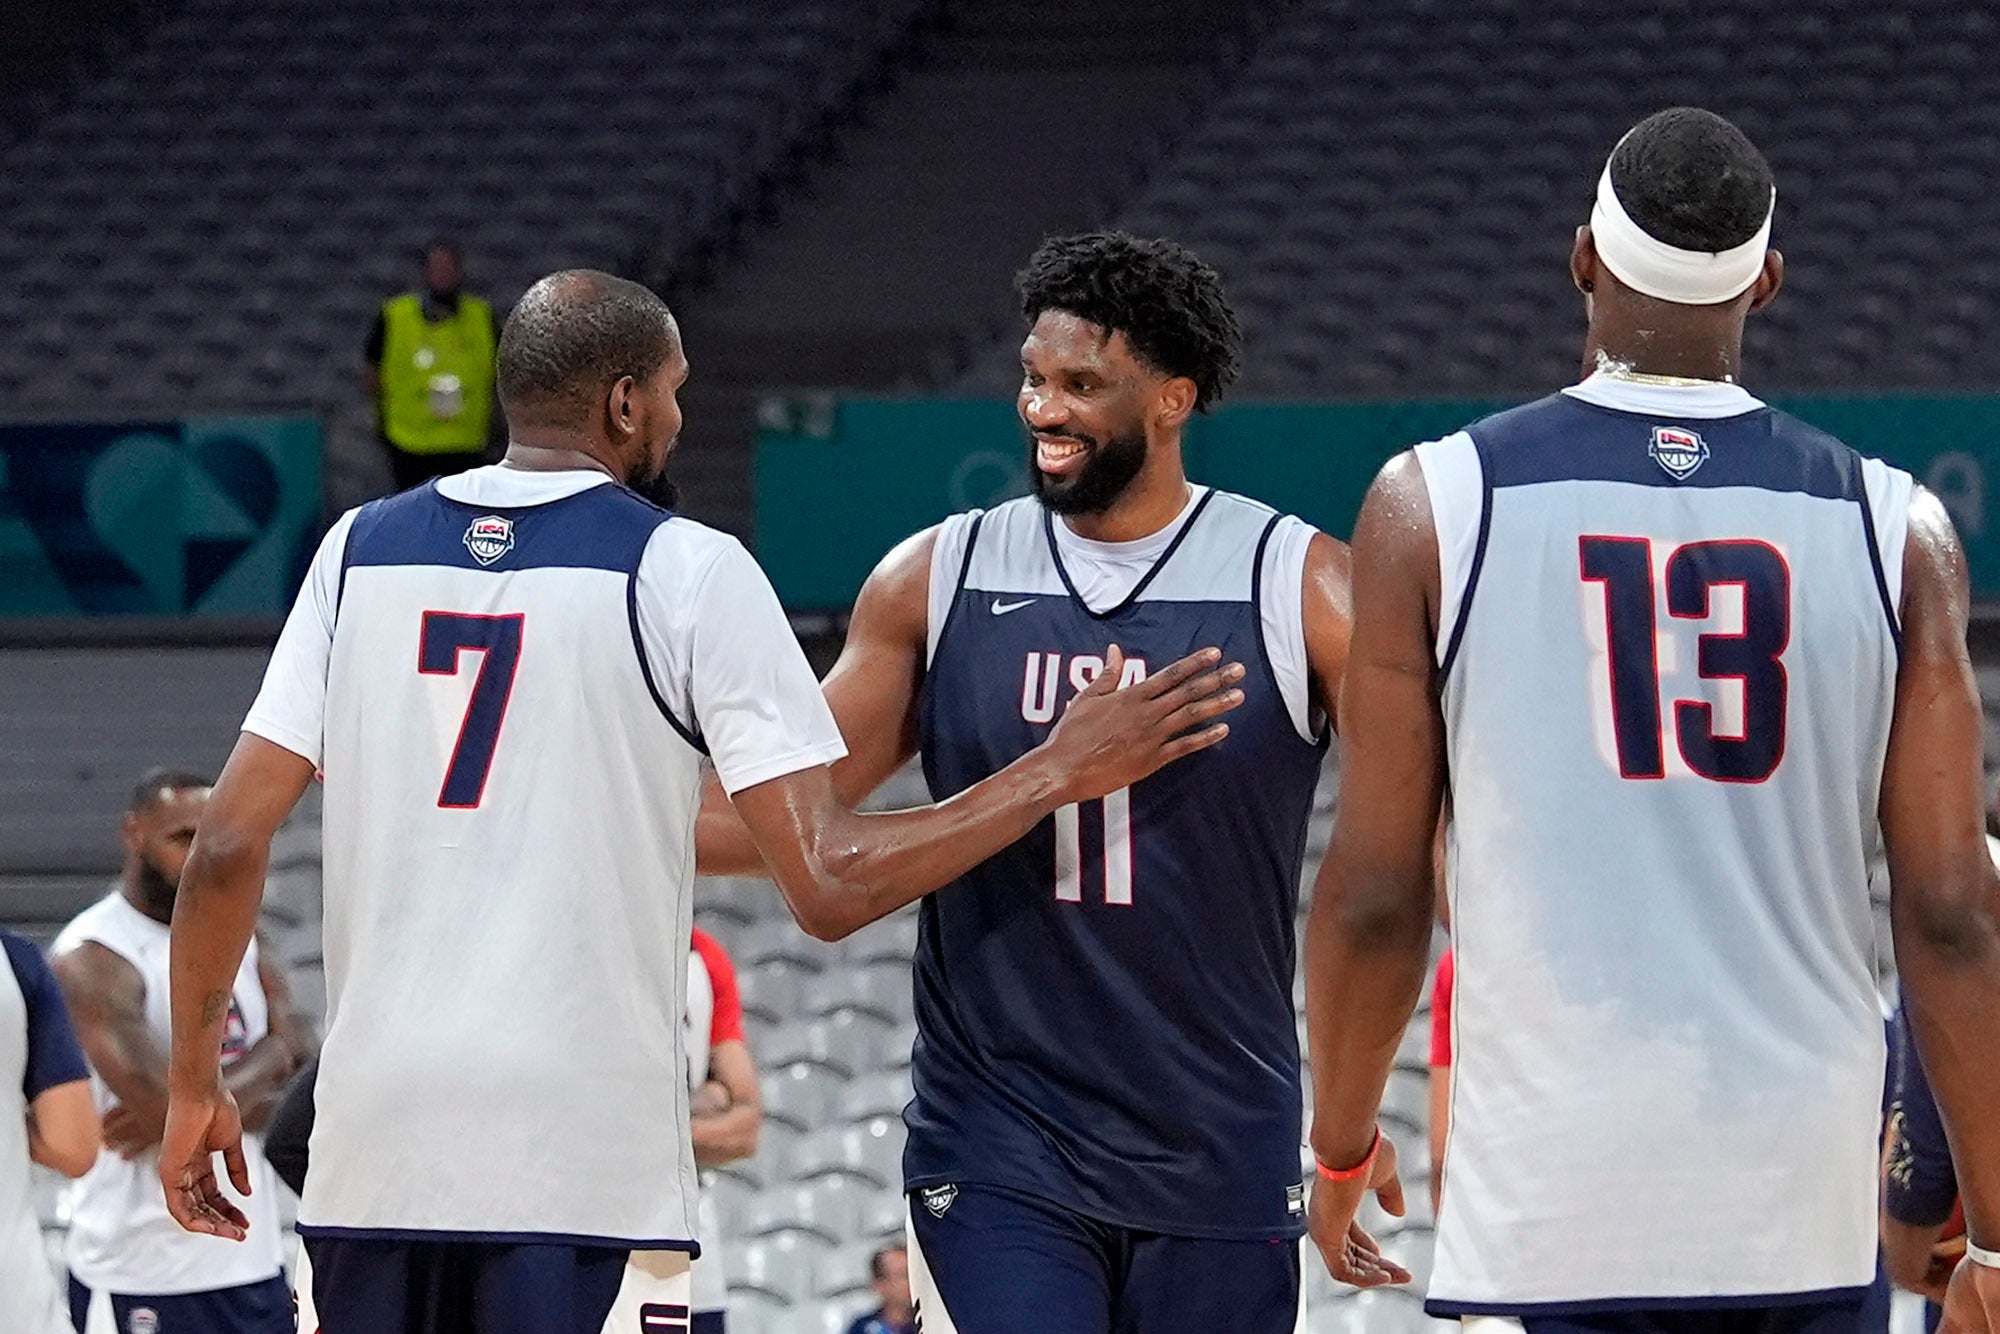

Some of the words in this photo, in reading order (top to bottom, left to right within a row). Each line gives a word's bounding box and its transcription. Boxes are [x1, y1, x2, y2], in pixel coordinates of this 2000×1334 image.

[476, 524, 505, 537] USA
[417, 610, 525, 809] 7
[1578, 534, 1791, 785] 13
[1053, 783, 1135, 906] 11
